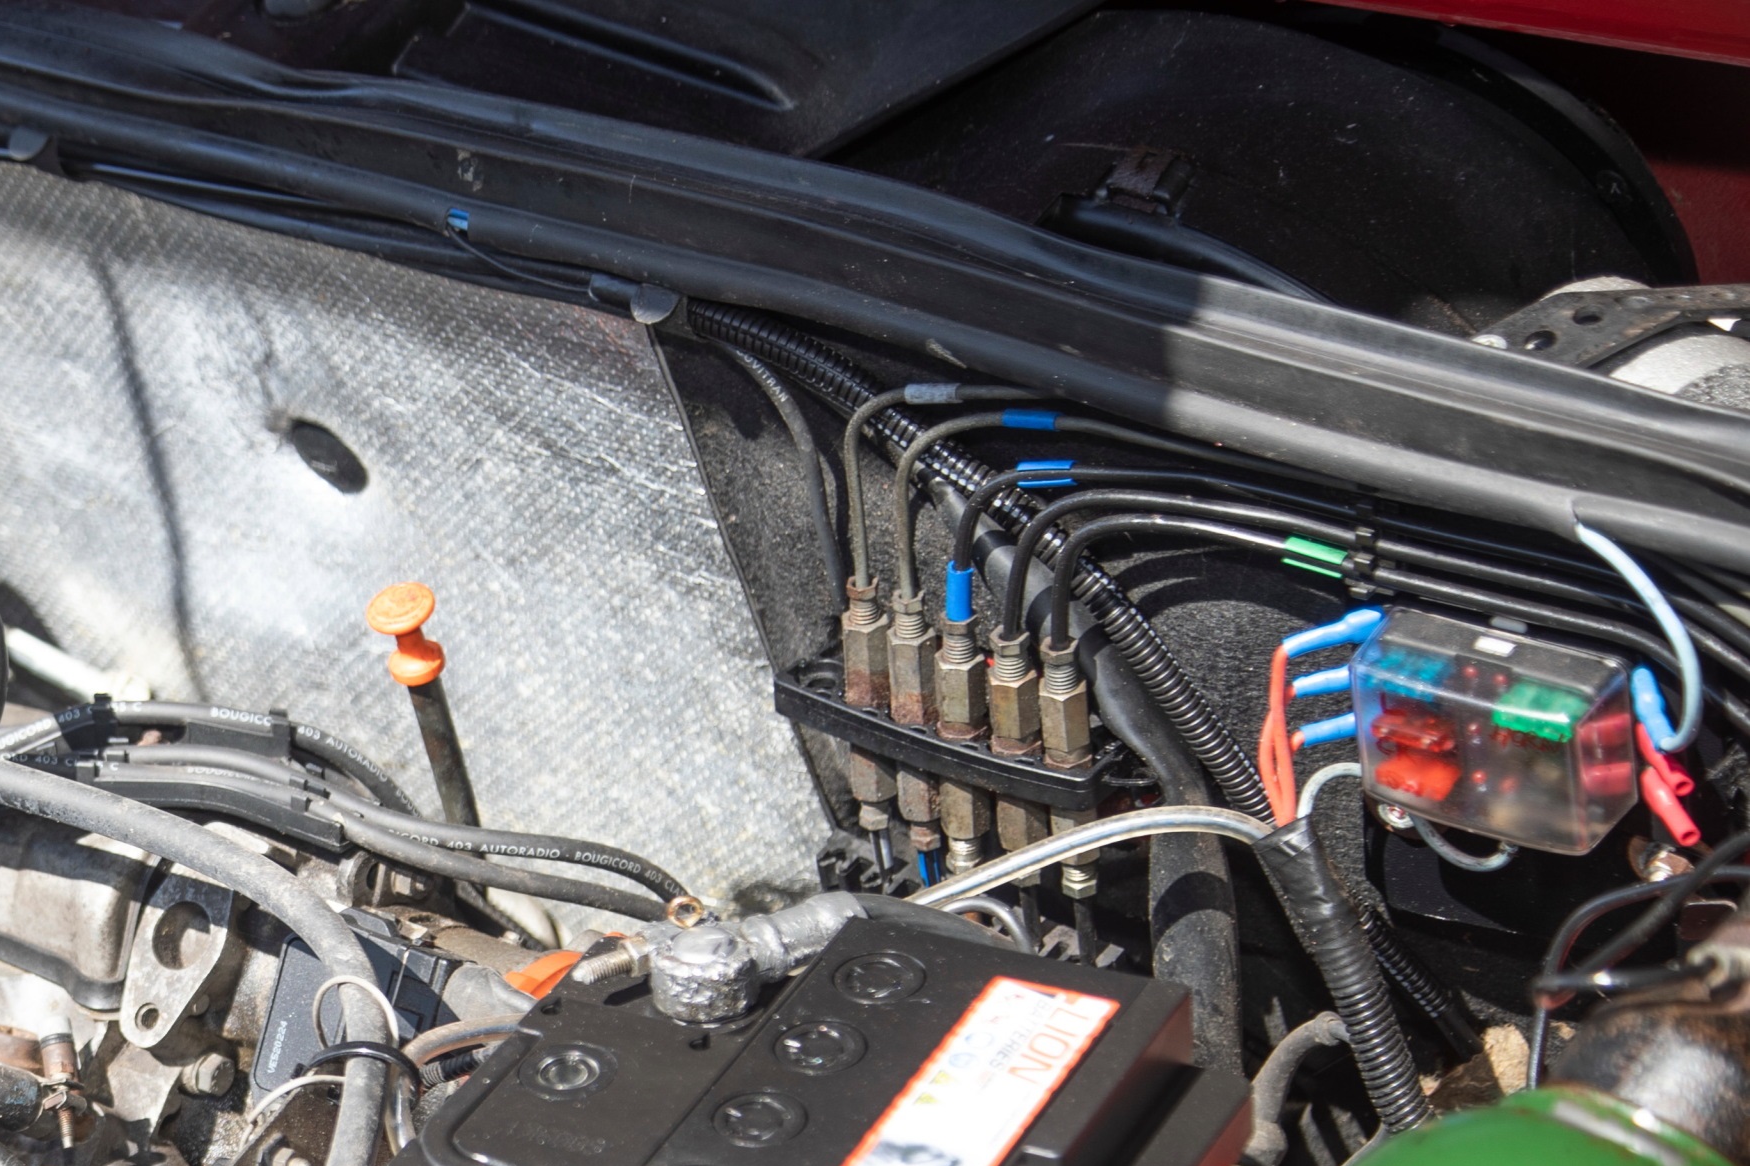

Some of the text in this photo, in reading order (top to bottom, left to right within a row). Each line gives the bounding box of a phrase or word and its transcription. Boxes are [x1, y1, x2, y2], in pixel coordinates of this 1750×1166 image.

[58, 709, 81, 724] 403
[298, 725, 321, 741] 403
[35, 754, 58, 765] 403
[479, 843, 561, 859] AUTORADIO
[574, 851, 641, 874] BOUGICORD
[644, 869, 663, 884] 403
[989, 999, 1052, 1072] BATTERIES
[1008, 1007, 1090, 1085] LION
